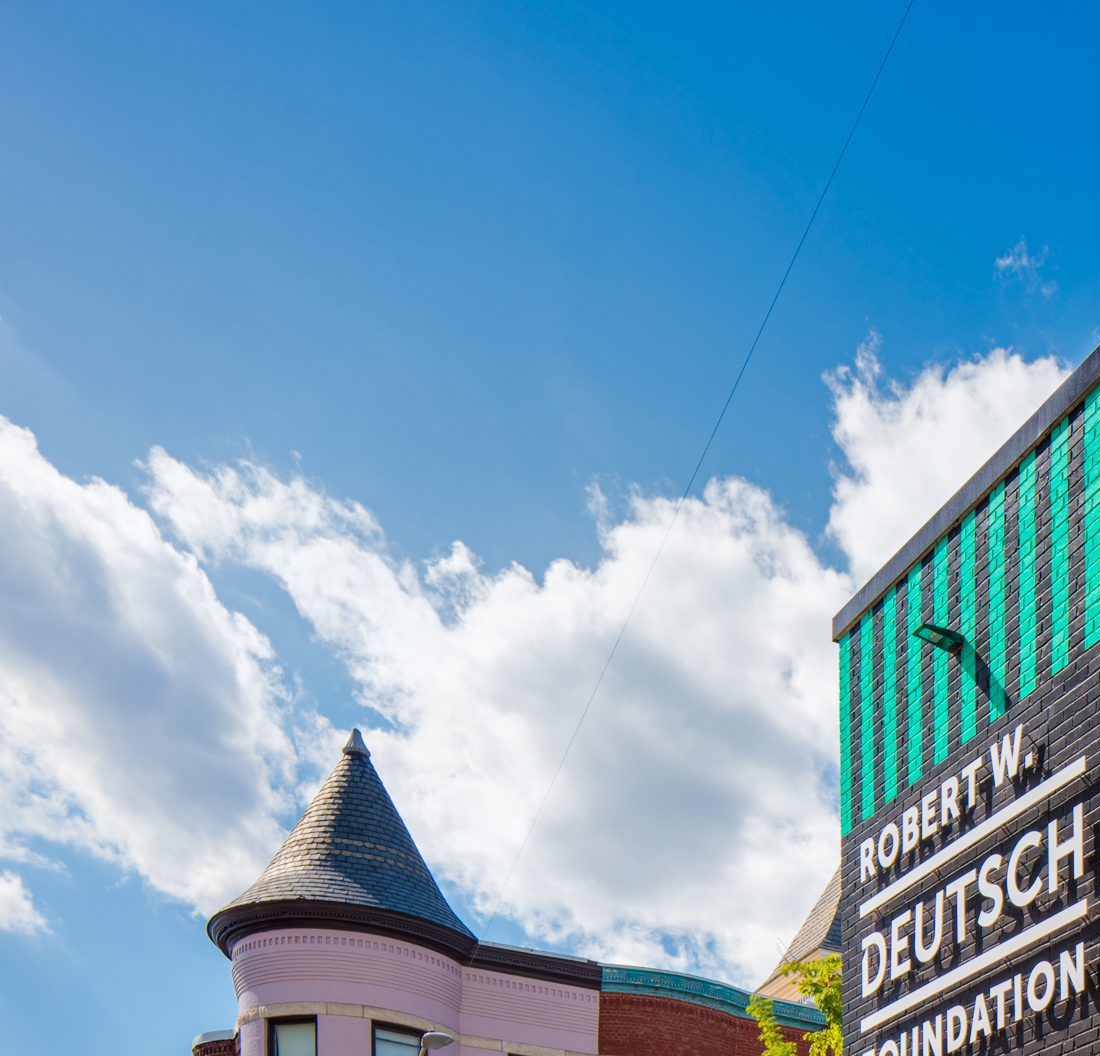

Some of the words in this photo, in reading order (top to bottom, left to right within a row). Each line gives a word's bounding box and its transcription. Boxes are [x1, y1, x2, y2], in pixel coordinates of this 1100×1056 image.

[860, 756, 982, 883] ROBERT
[990, 723, 1033, 787] W.
[861, 802, 1084, 998] DEUTSCH
